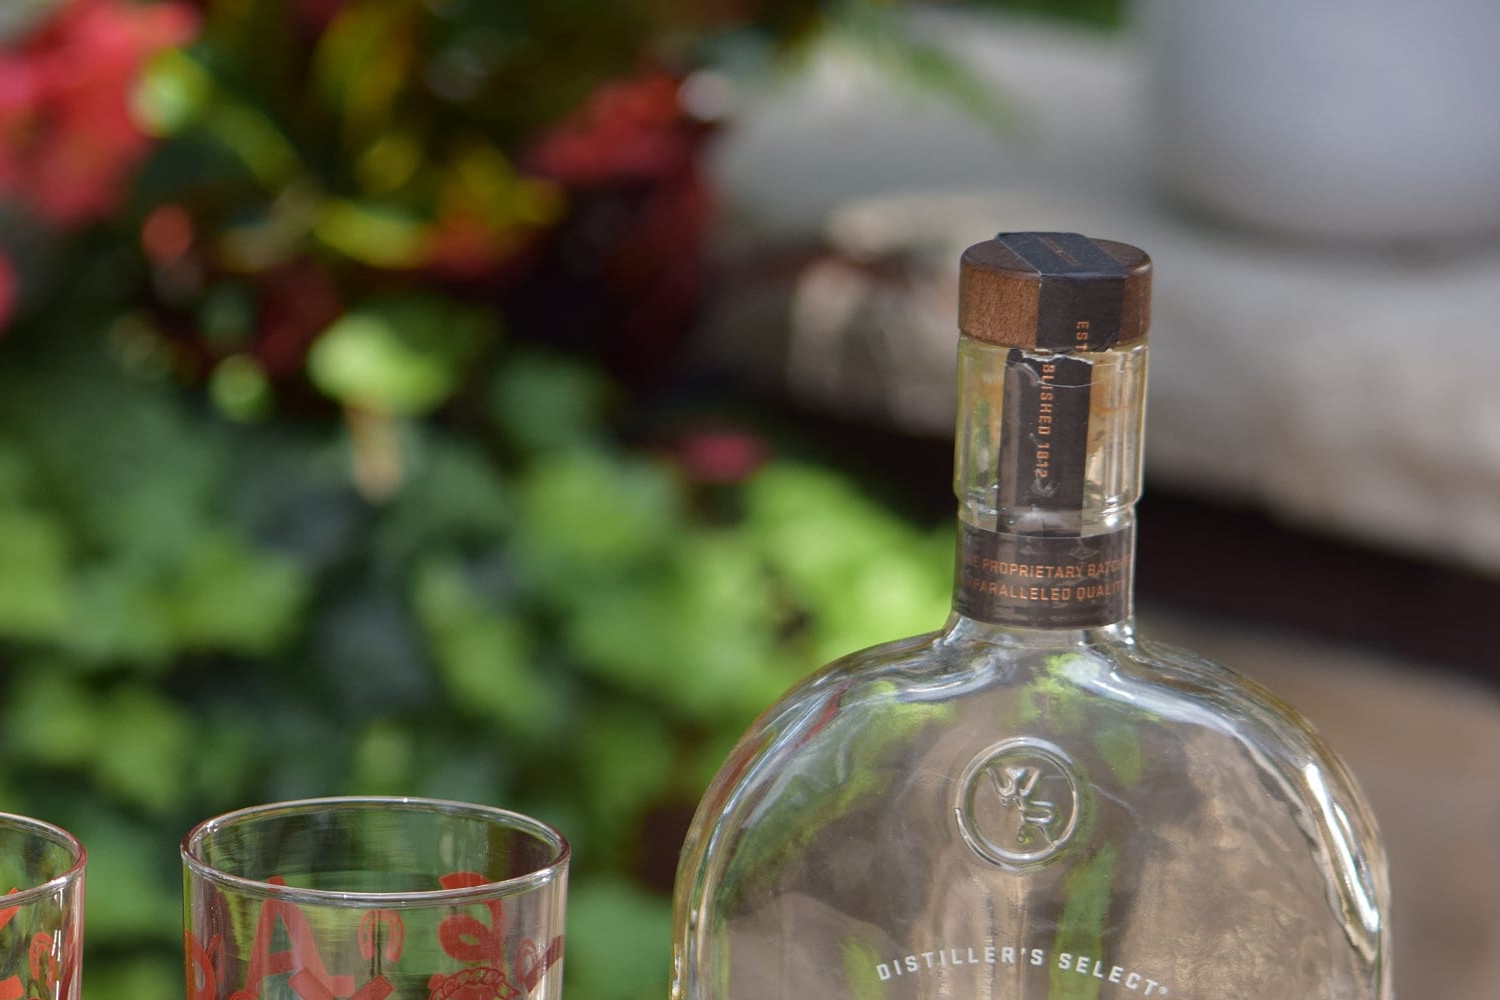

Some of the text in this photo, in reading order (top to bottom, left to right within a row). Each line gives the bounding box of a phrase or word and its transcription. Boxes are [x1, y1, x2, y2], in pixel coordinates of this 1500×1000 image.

[1033, 442, 1051, 479] 1812
[982, 557, 1083, 579] PROPRIETARY
[875, 946, 1044, 981] DISTILLER'S
